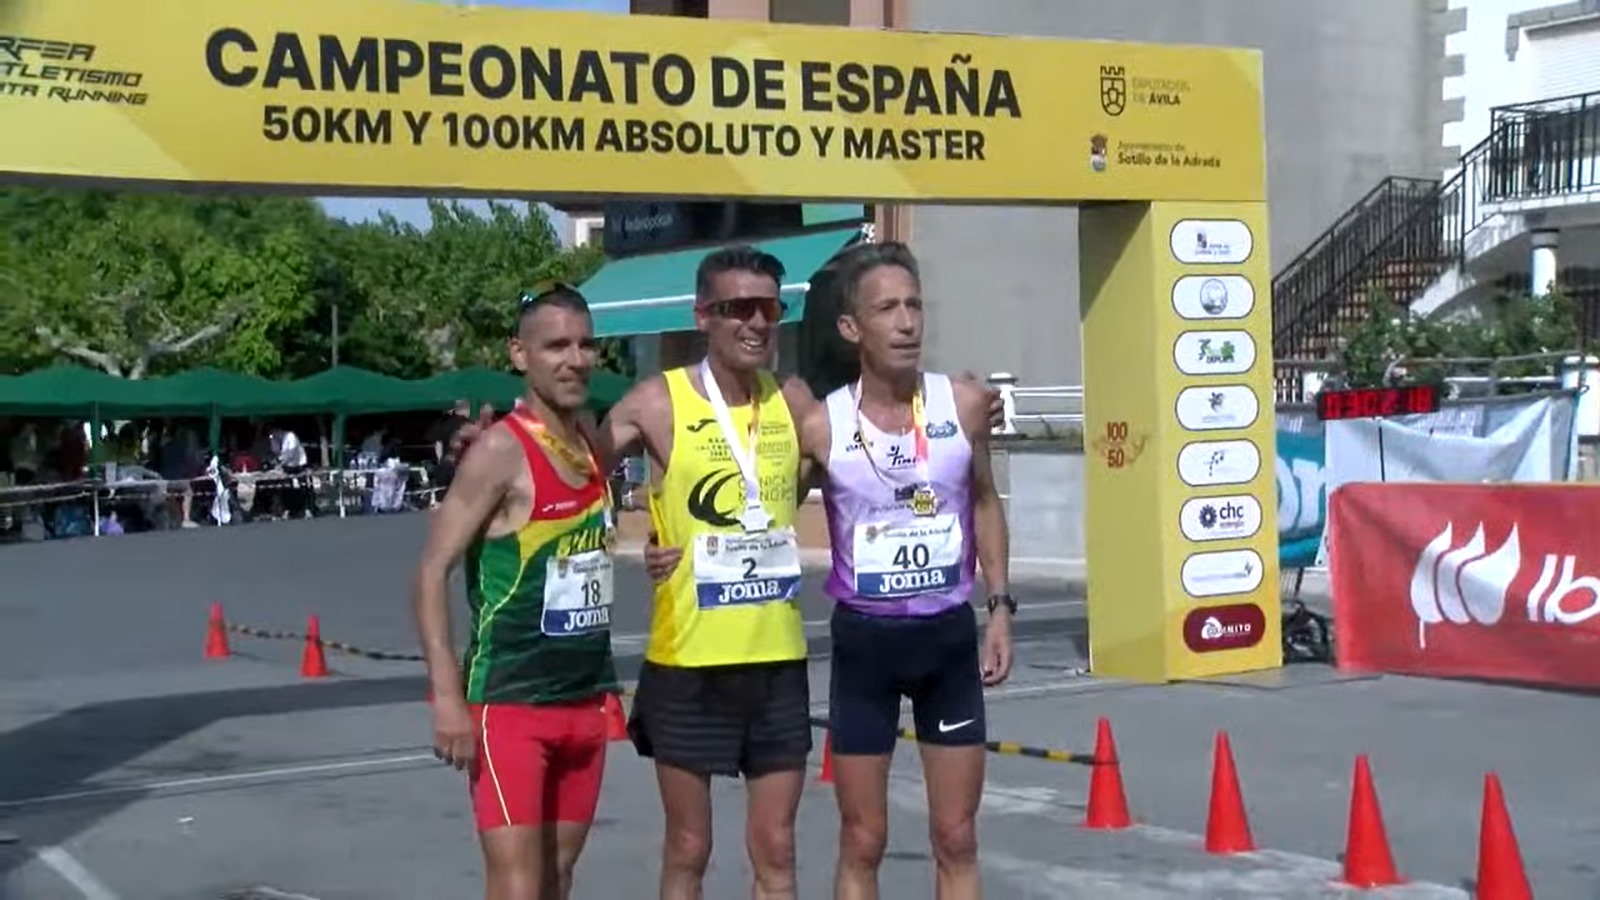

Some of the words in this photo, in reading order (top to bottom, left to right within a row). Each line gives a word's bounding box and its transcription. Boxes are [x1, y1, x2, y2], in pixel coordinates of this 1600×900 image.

[205, 27, 695, 107] CAMPEONATO
[711, 56, 787, 110] DE
[801, 52, 1022, 118] ESPAÑA
[48, 86, 148, 106] RUNNING
[263, 105, 392, 145] 50KM
[402, 110, 432, 146] Y
[442, 112, 585, 151] 100KM
[595, 119, 801, 157] ABSOLUTO
[810, 126, 834, 158] Y
[843, 127, 986, 161] MASTER
[1107, 422, 1128, 441] 100
[1107, 448, 1124, 468] 50
[1219, 501, 1244, 519] chc
[892, 543, 930, 570] 40
[741, 557, 759, 580] 2
[581, 579, 601, 606] 18
